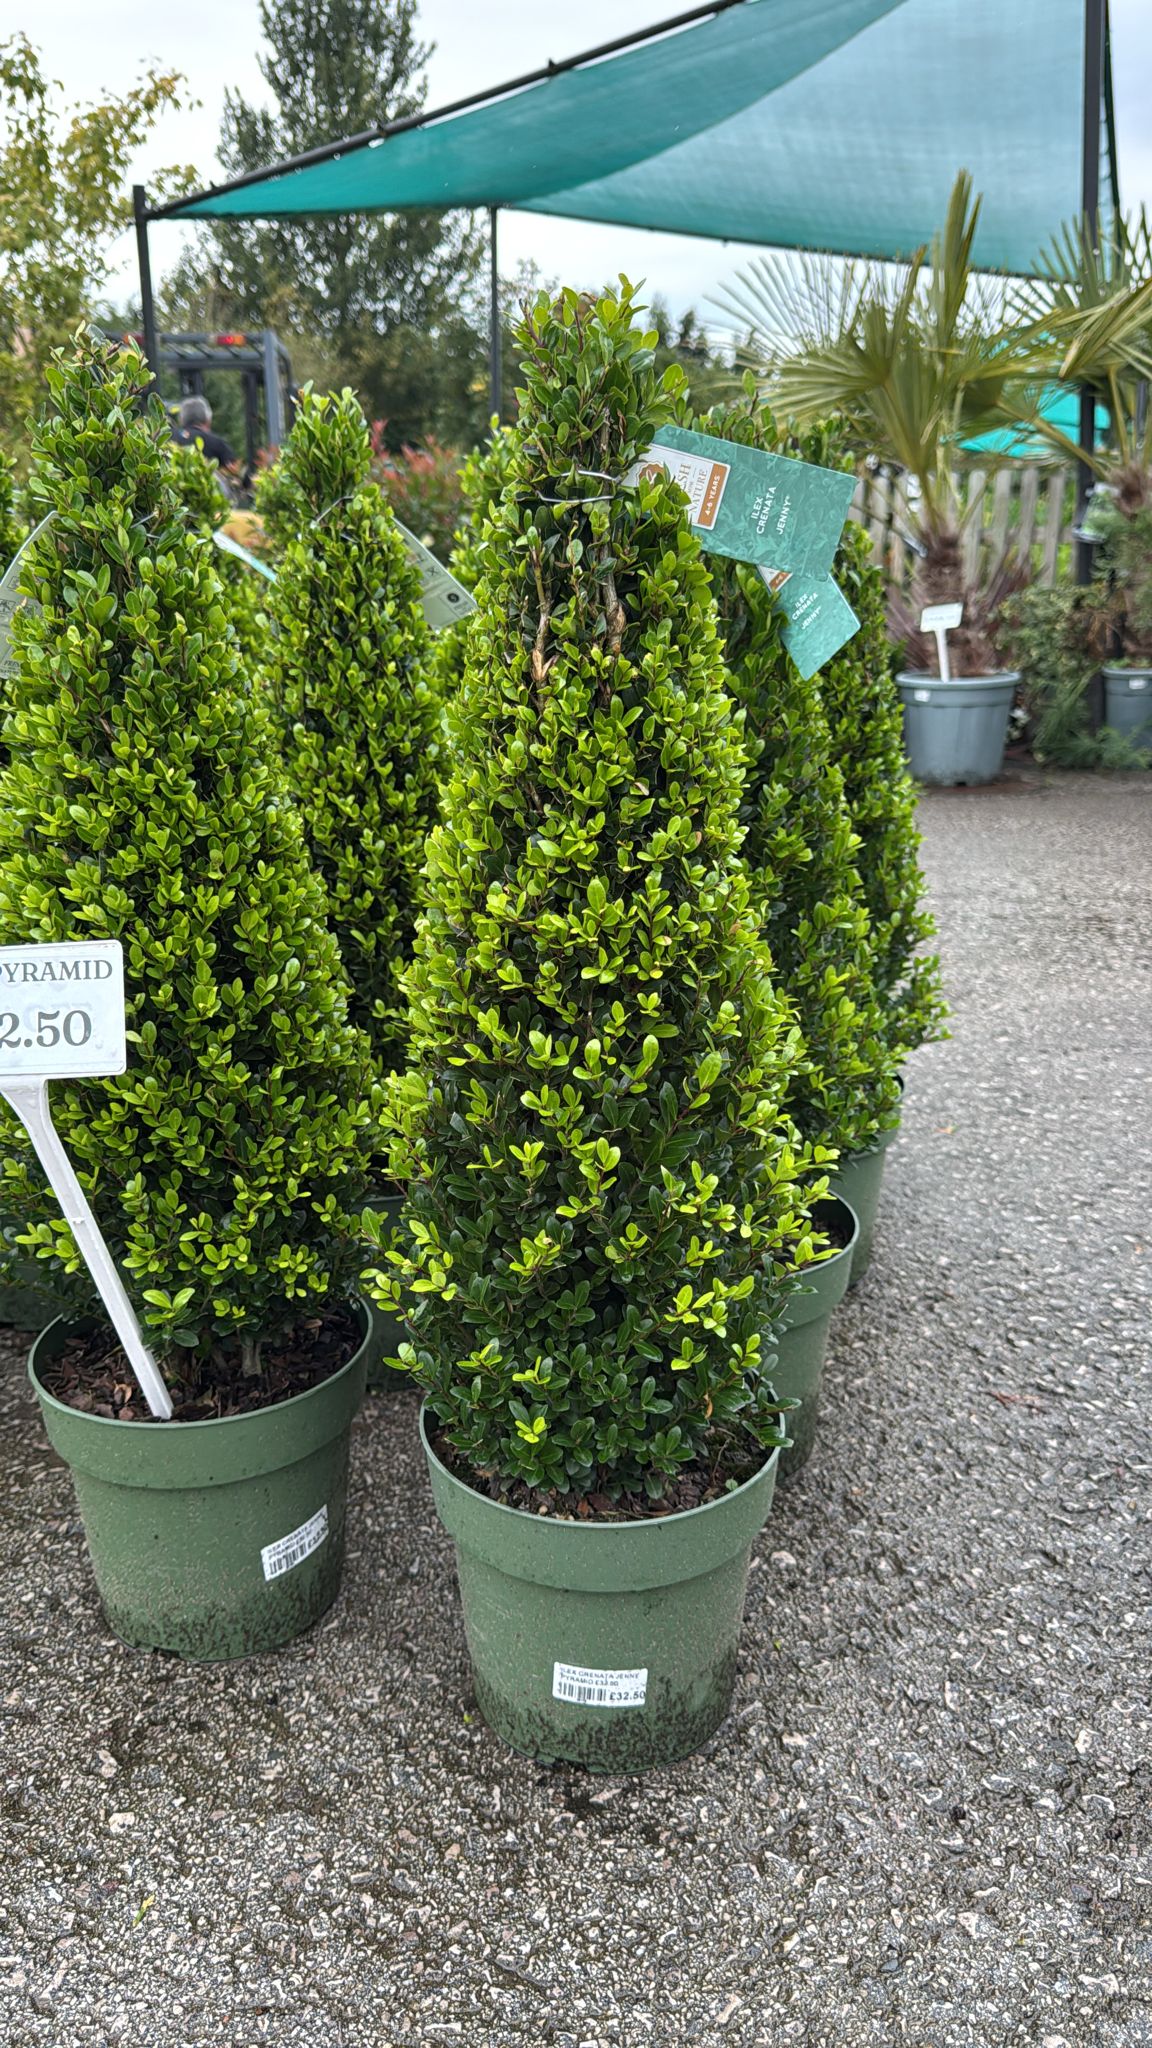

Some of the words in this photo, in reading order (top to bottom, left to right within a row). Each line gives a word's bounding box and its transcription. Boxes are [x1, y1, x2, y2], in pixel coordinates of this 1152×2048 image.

[689, 468, 707, 513] NATURE
[704, 502, 713, 516] 4-6
[709, 475, 721, 500] YEARS
[751, 496, 764, 519] ILEX
[756, 486, 776, 534] CRENATA
[792, 592, 818, 620] CRENATA
[795, 593, 808, 608] ILEX
[0, 960, 112, 983] YRAMID
[0, 1009, 92, 1049] 2.50
[609, 1690, 646, 1701] £32.50
